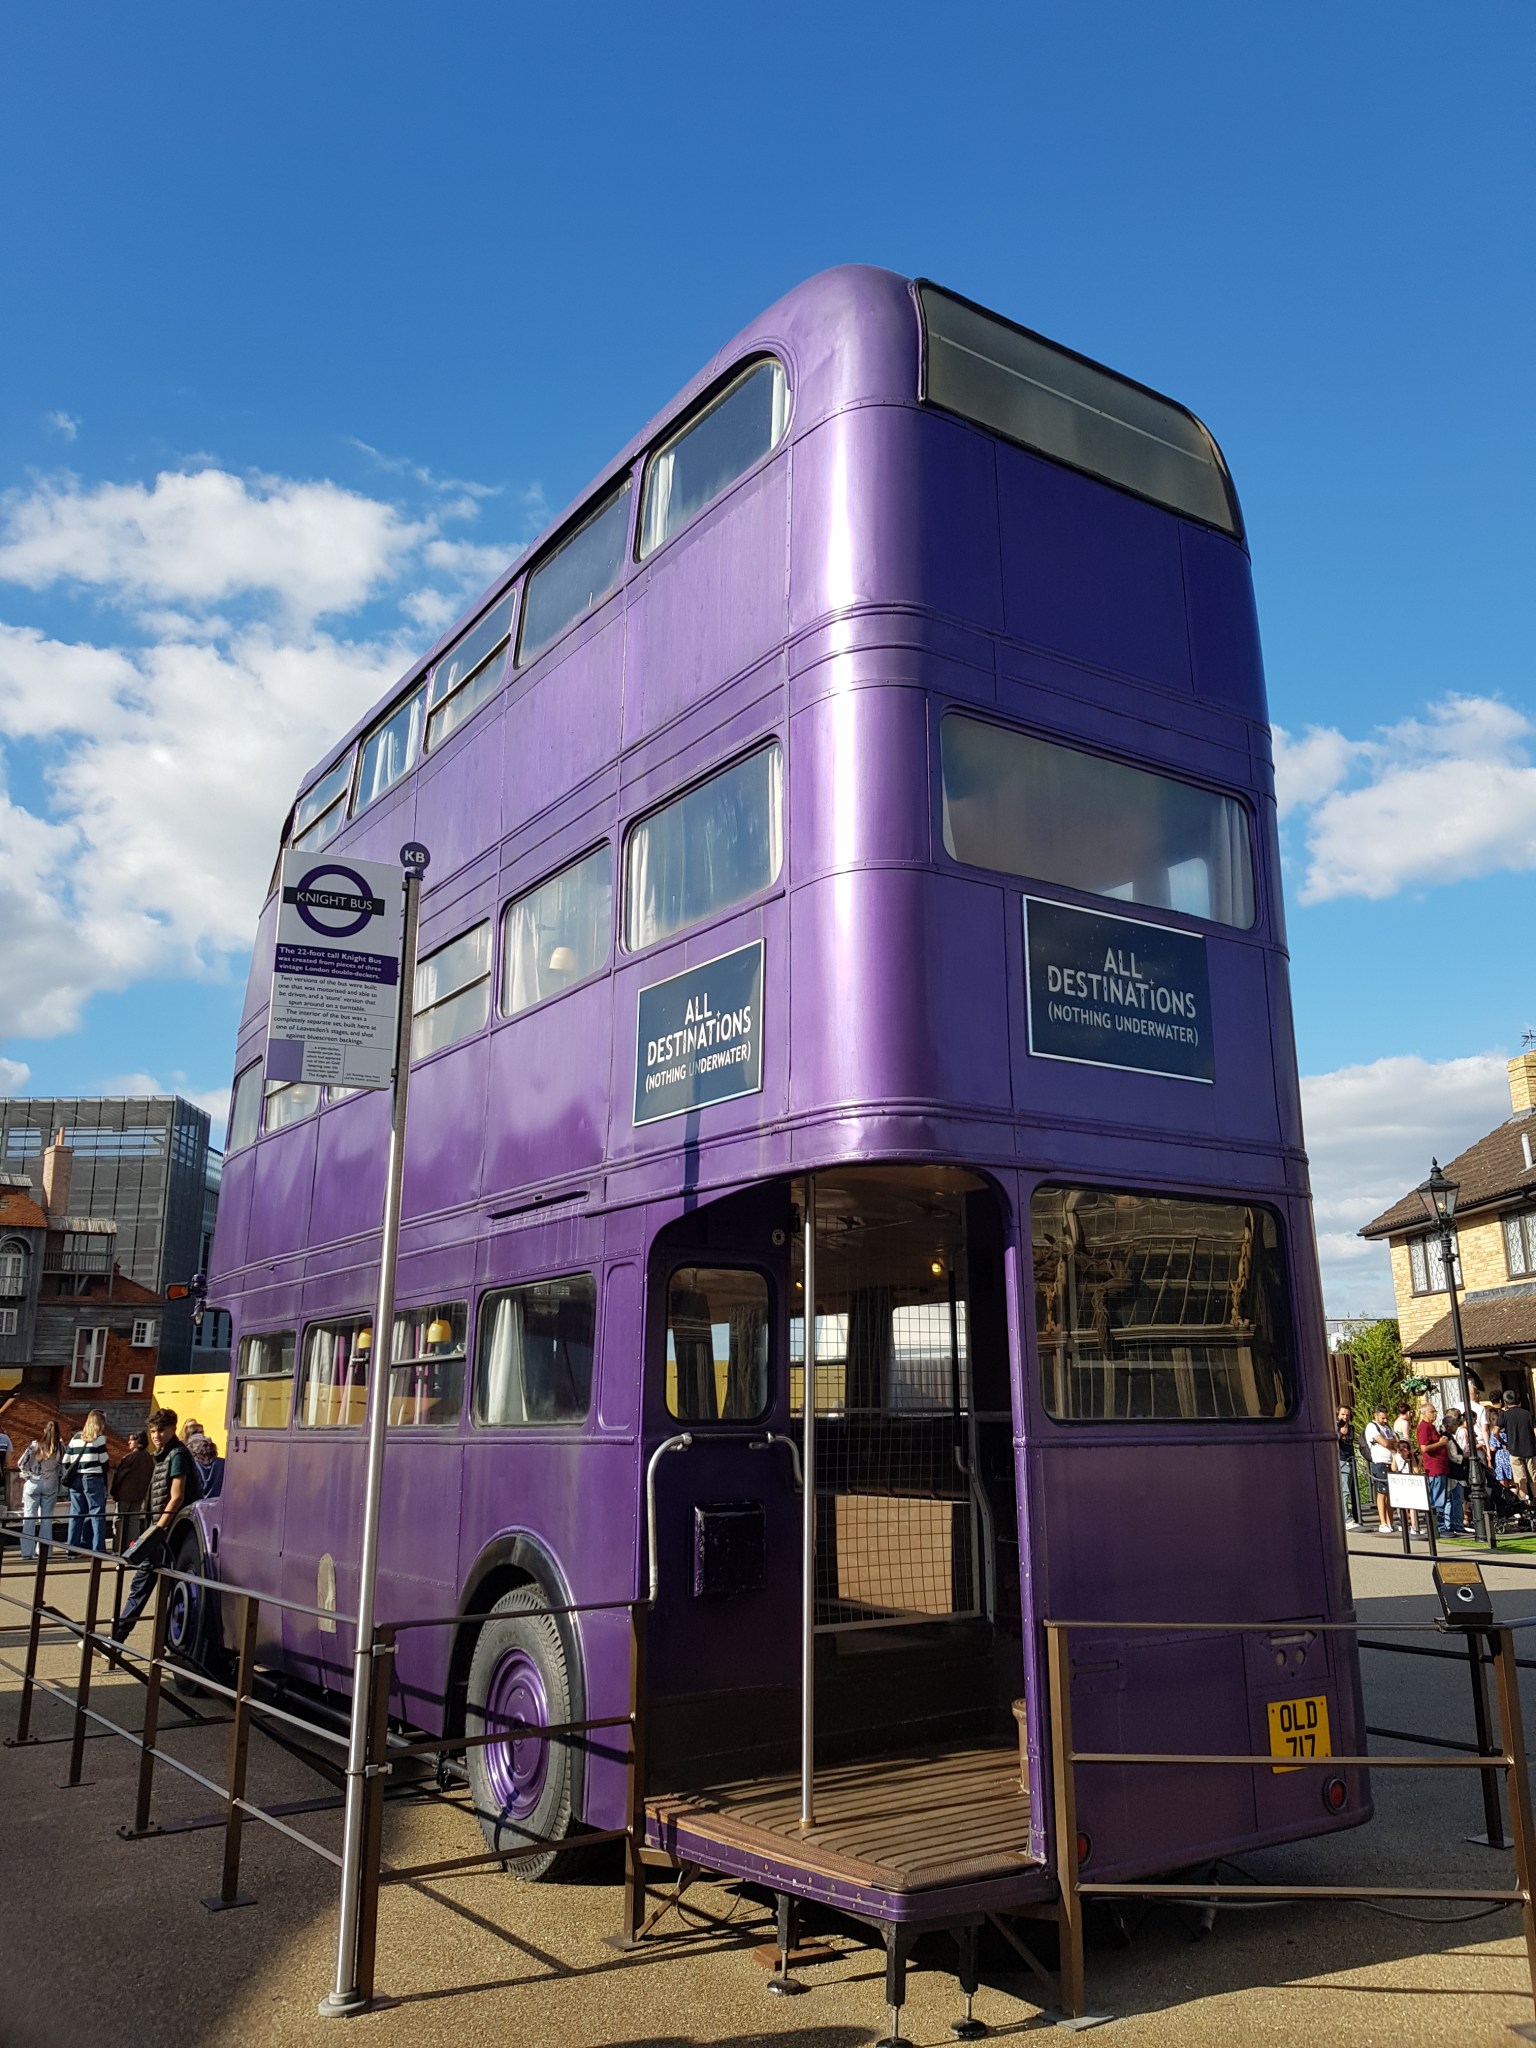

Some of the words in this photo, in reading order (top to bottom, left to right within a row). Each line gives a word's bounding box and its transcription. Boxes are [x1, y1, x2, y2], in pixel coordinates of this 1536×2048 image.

[405, 850, 425, 863] KB
[297, 891, 347, 906] KNIGHT
[351, 899, 372, 910] BUS
[297, 949, 325, 957] 22-foot
[342, 953, 366, 962] Knight
[1104, 948, 1142, 978] ALL
[331, 968, 379, 979] double-deckers.
[1047, 965, 1196, 1018] DESTINATIONS
[340, 1004, 366, 1012] turntable.
[685, 993, 712, 1025] ALL
[297, 1025, 329, 1033] Leavesden's
[1048, 1001, 1111, 1029] (NOTHING
[1115, 1016, 1199, 1047] UNDERWATER)
[307, 1034, 337, 1042] bluescreen
[340, 1036, 363, 1045] backings.
[648, 1006, 751, 1066] DESTINATIONS
[645, 1064, 686, 1093] (NOTHING
[689, 1041, 751, 1076] UNDERWATER)
[1280, 1701, 1317, 1732] OLD
[1286, 1734, 1315, 1757] 717
